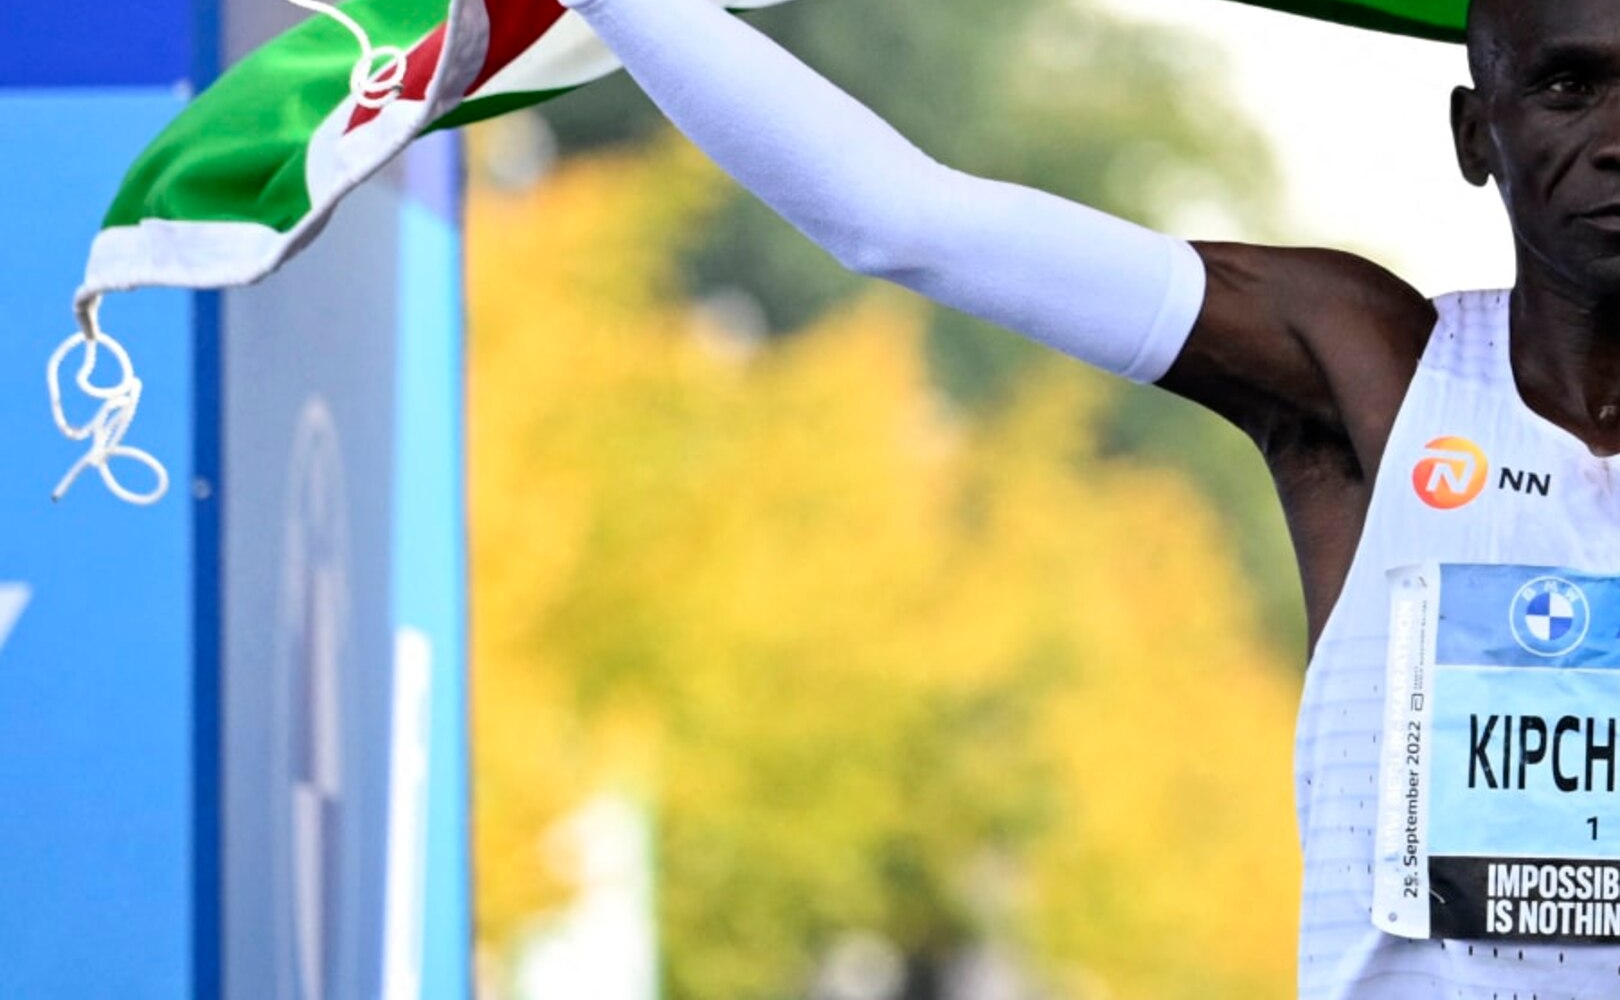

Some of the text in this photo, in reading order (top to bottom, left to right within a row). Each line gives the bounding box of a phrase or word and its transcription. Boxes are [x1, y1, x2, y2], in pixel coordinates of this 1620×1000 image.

[1499, 467, 1551, 497] NN
[1406, 720, 1422, 767] 2022
[1403, 769, 1420, 868] September
[1586, 816, 1599, 841] 1
[1486, 899, 1513, 934] IS
